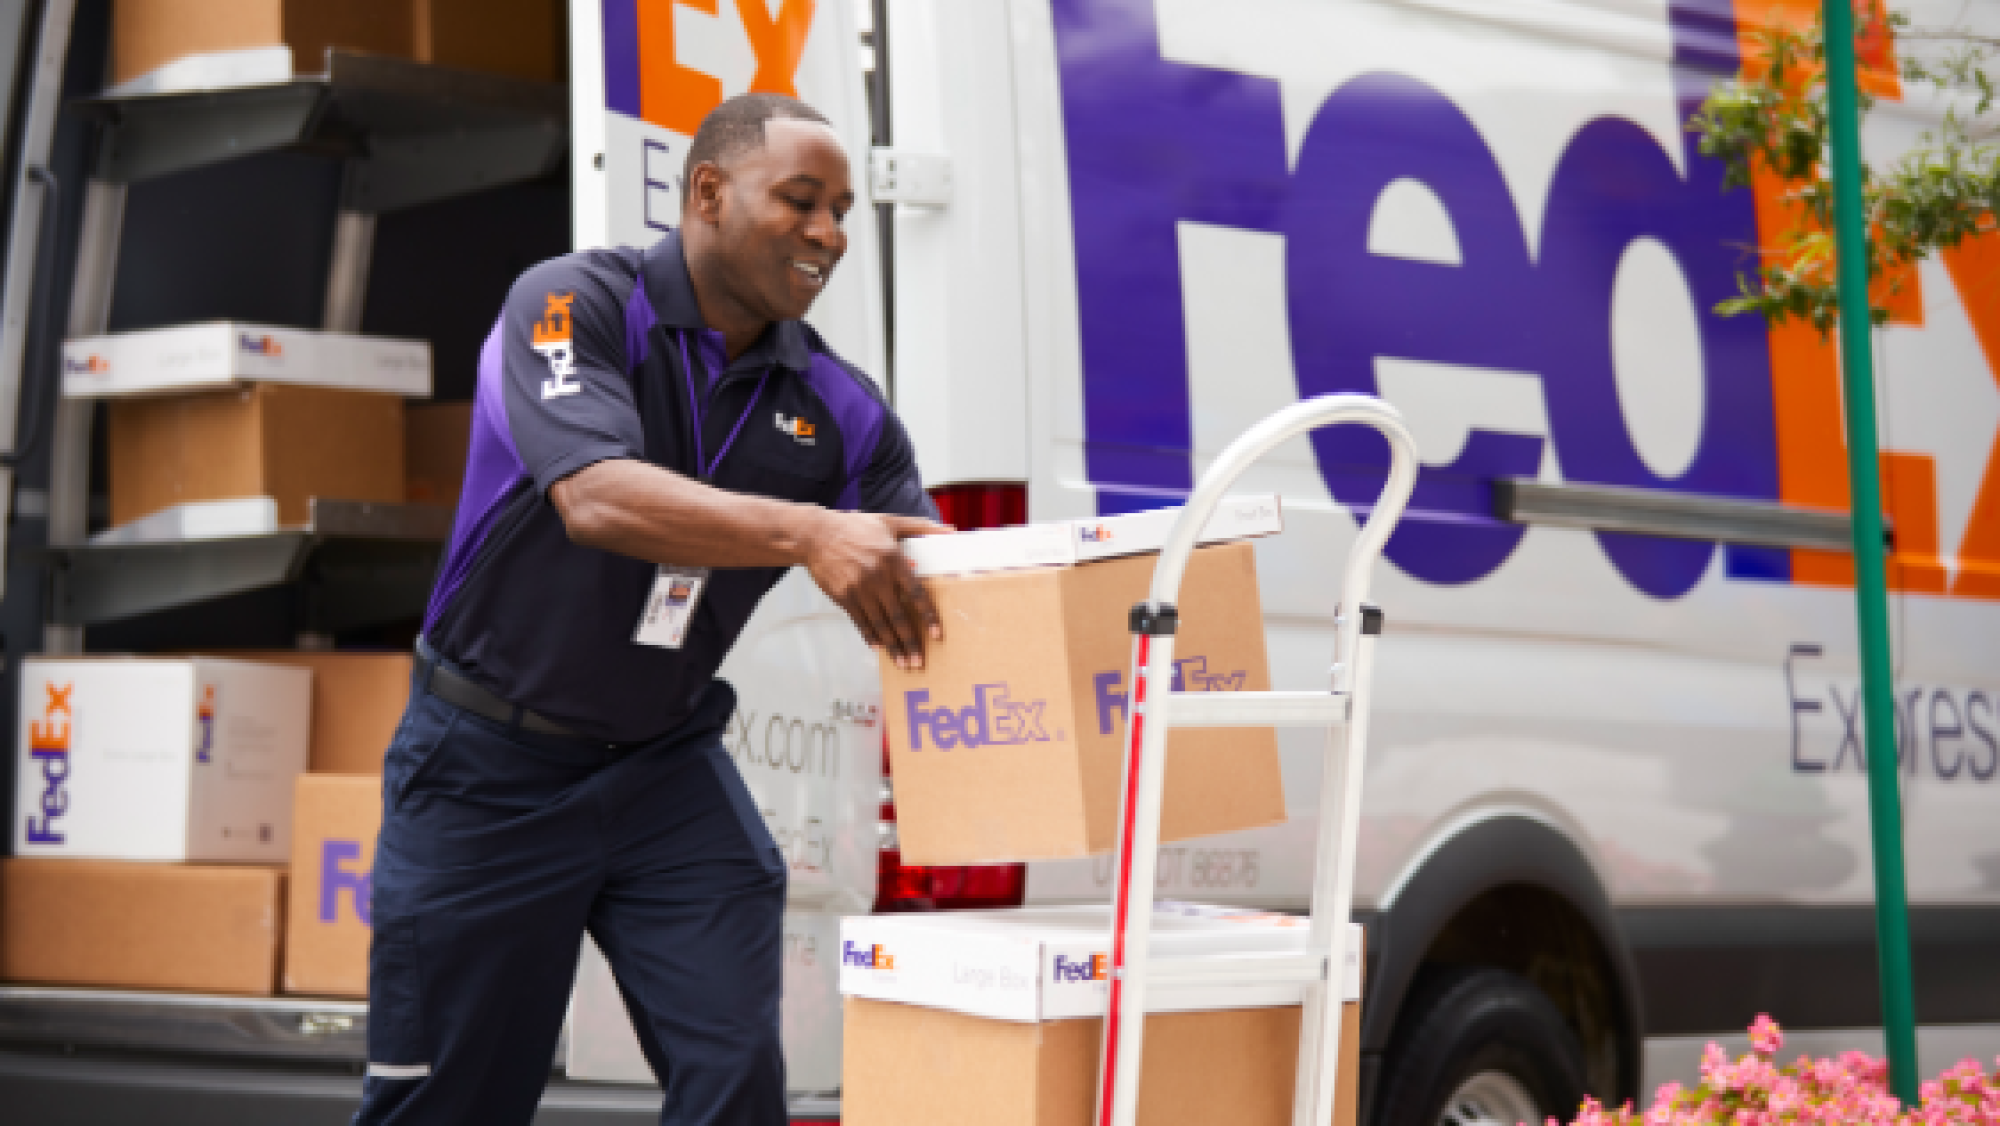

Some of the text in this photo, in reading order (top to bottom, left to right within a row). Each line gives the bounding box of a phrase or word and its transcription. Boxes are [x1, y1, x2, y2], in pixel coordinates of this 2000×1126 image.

[532, 291, 578, 400] FedEx
[903, 680, 1052, 752] FedEx
[25, 680, 75, 846] FedEx
[842, 940, 897, 970] FedEx
